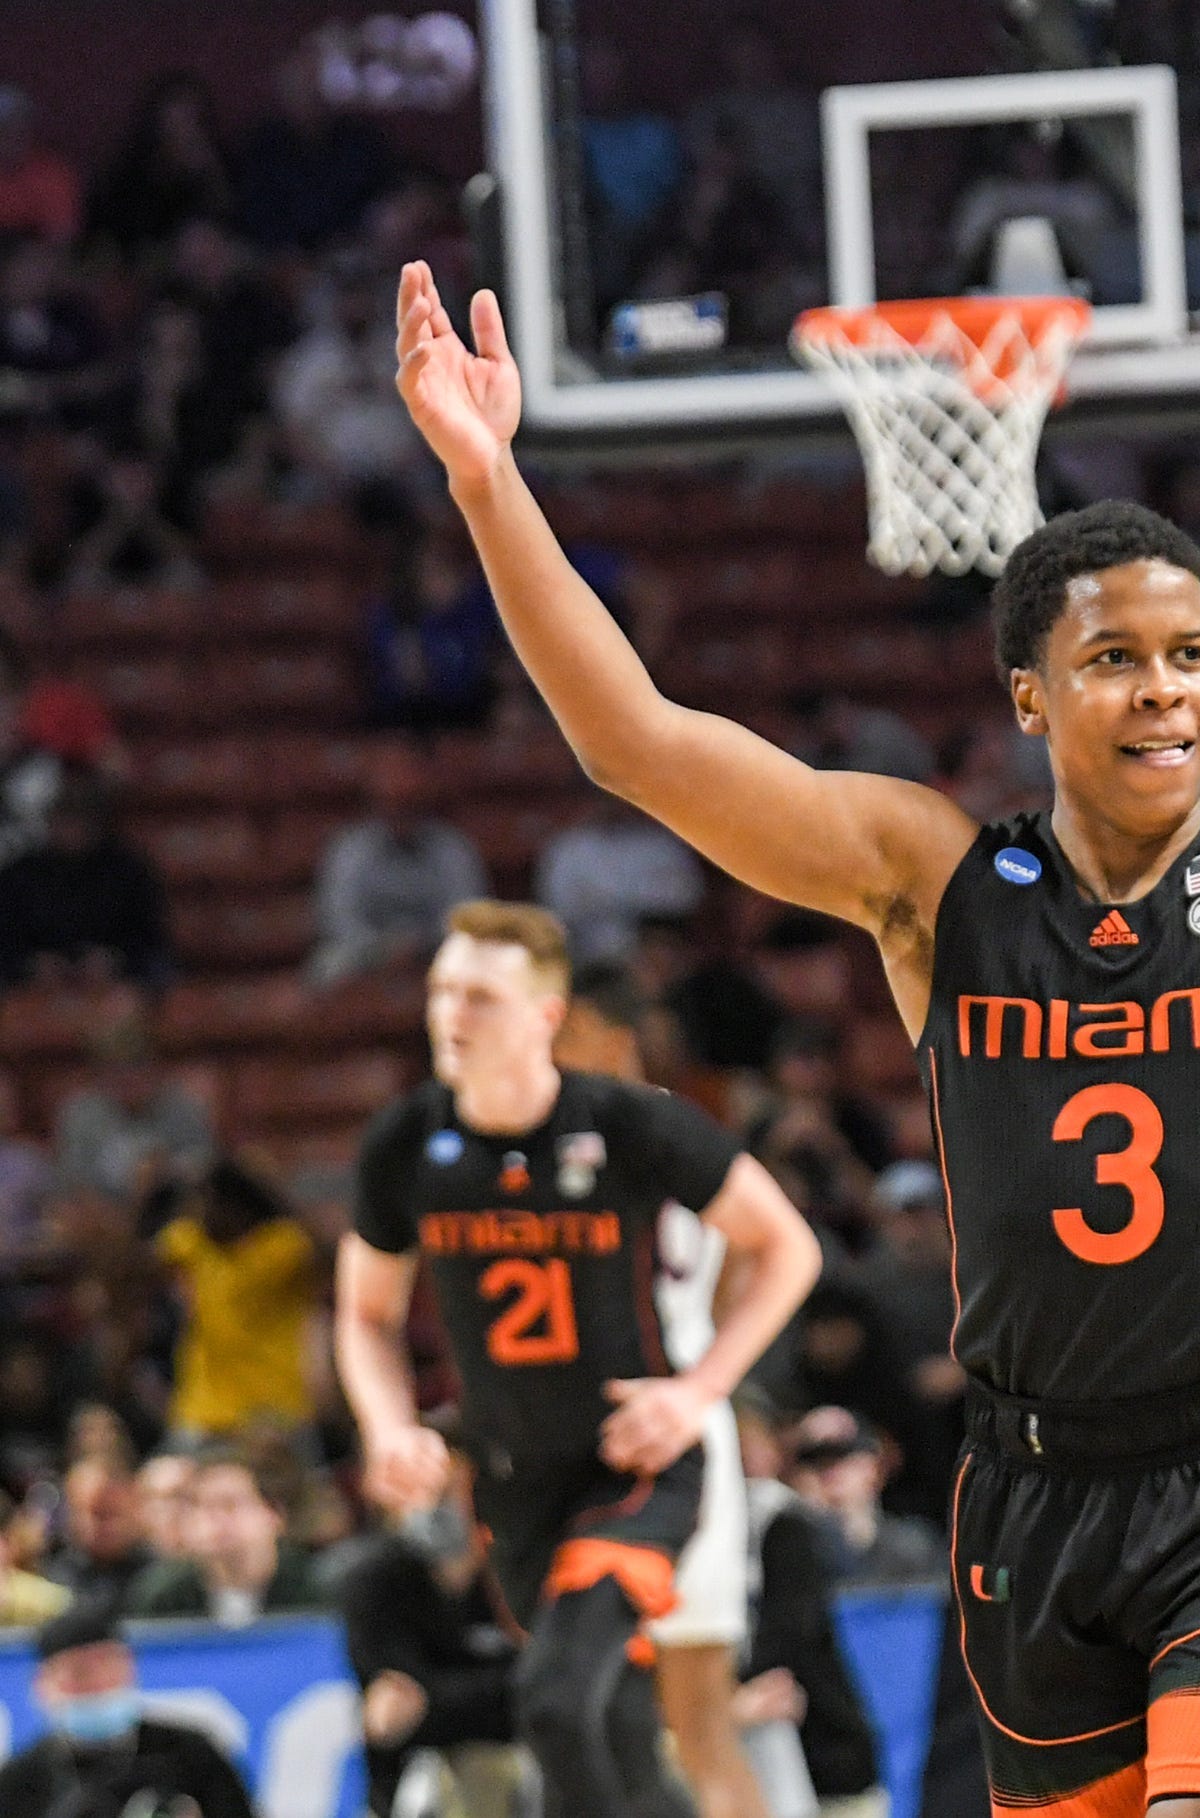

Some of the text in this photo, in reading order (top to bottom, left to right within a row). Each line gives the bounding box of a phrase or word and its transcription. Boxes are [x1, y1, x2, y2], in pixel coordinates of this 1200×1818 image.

[1000, 858, 1037, 881] NCAA
[1089, 932, 1140, 947] adidas
[1051, 1082, 1165, 1265] 3
[477, 1256, 581, 1367] 21
